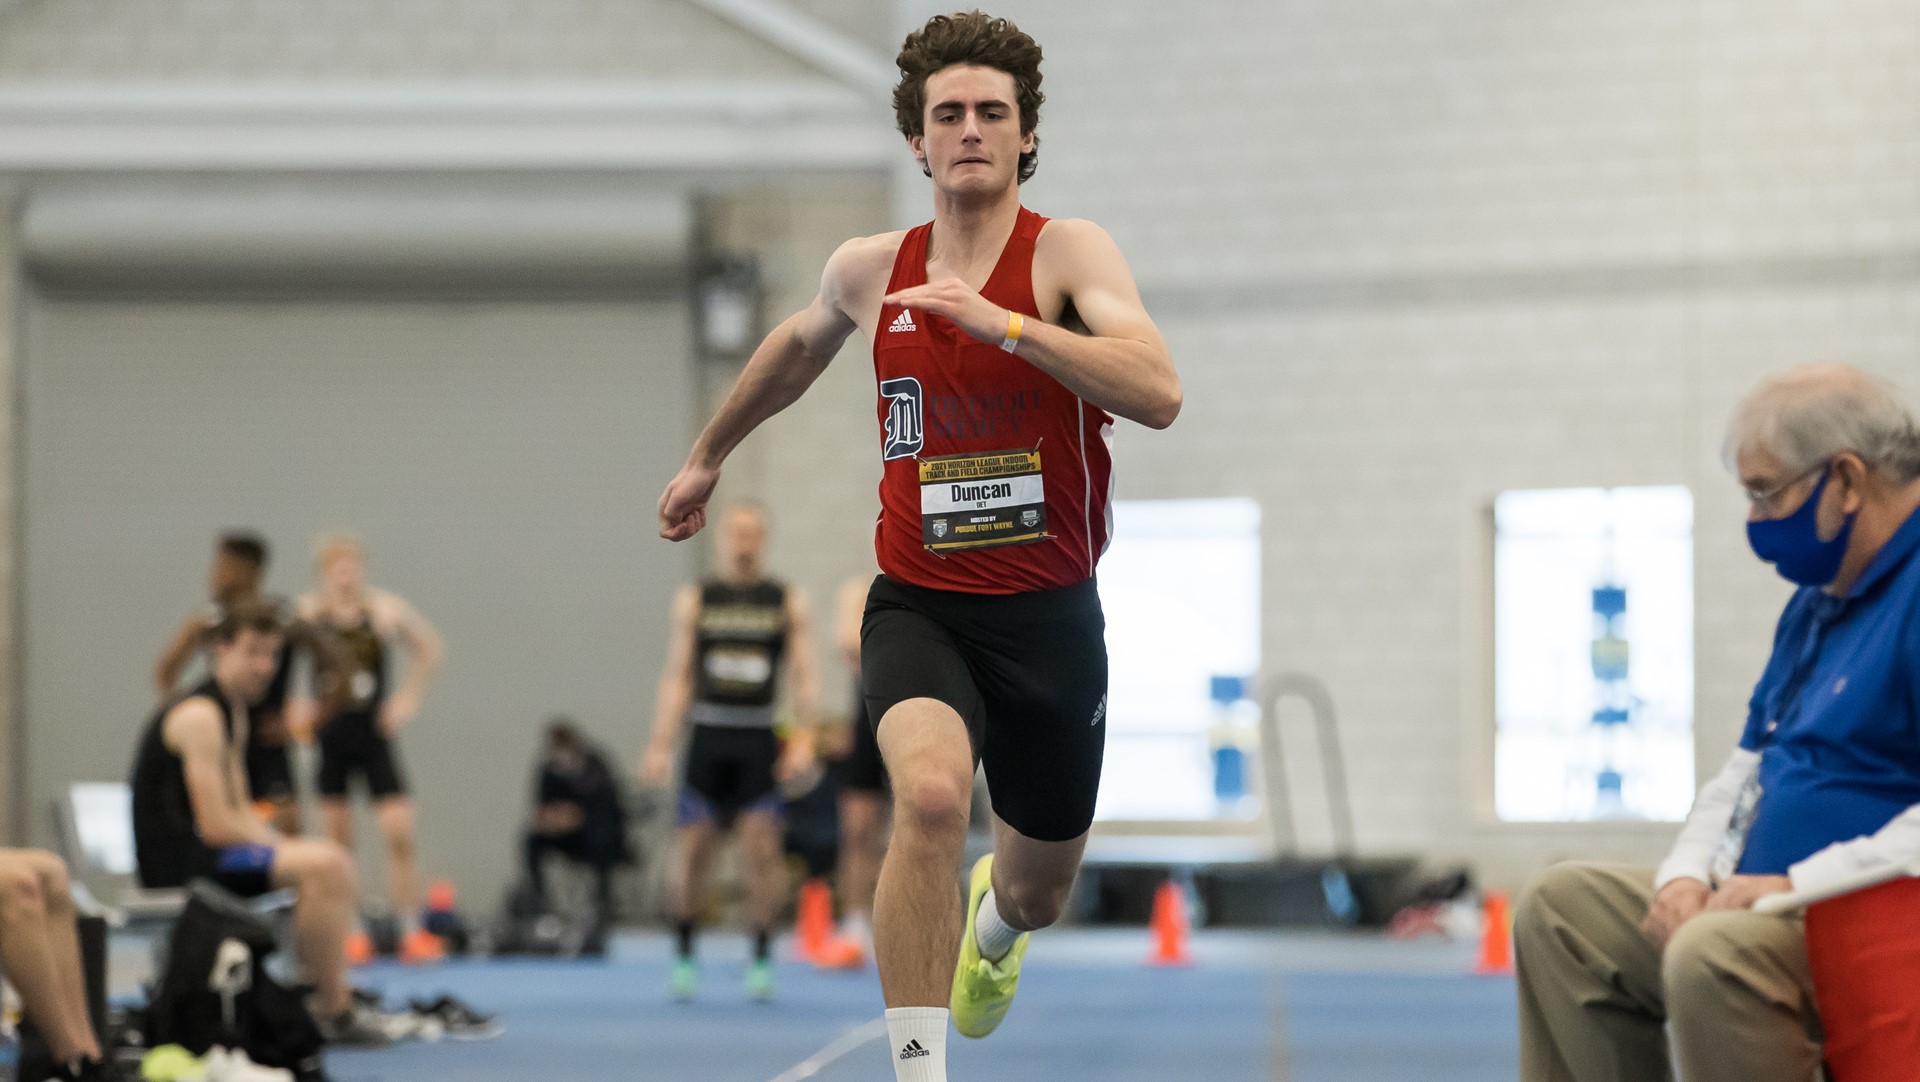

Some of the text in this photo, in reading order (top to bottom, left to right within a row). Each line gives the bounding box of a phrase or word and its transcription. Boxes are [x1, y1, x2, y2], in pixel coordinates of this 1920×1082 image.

[889, 323, 916, 332] adidas
[931, 455, 1029, 471] 2021 HORIZON LEAGUE INDOOR
[925, 462, 1036, 479] TRACK AND FIELD CHAMPIONSHIPS
[951, 483, 1011, 502] Duncan
[978, 523, 993, 532] FORT
[993, 521, 1013, 529] WAYNE
[900, 1050, 929, 1059] adidas
